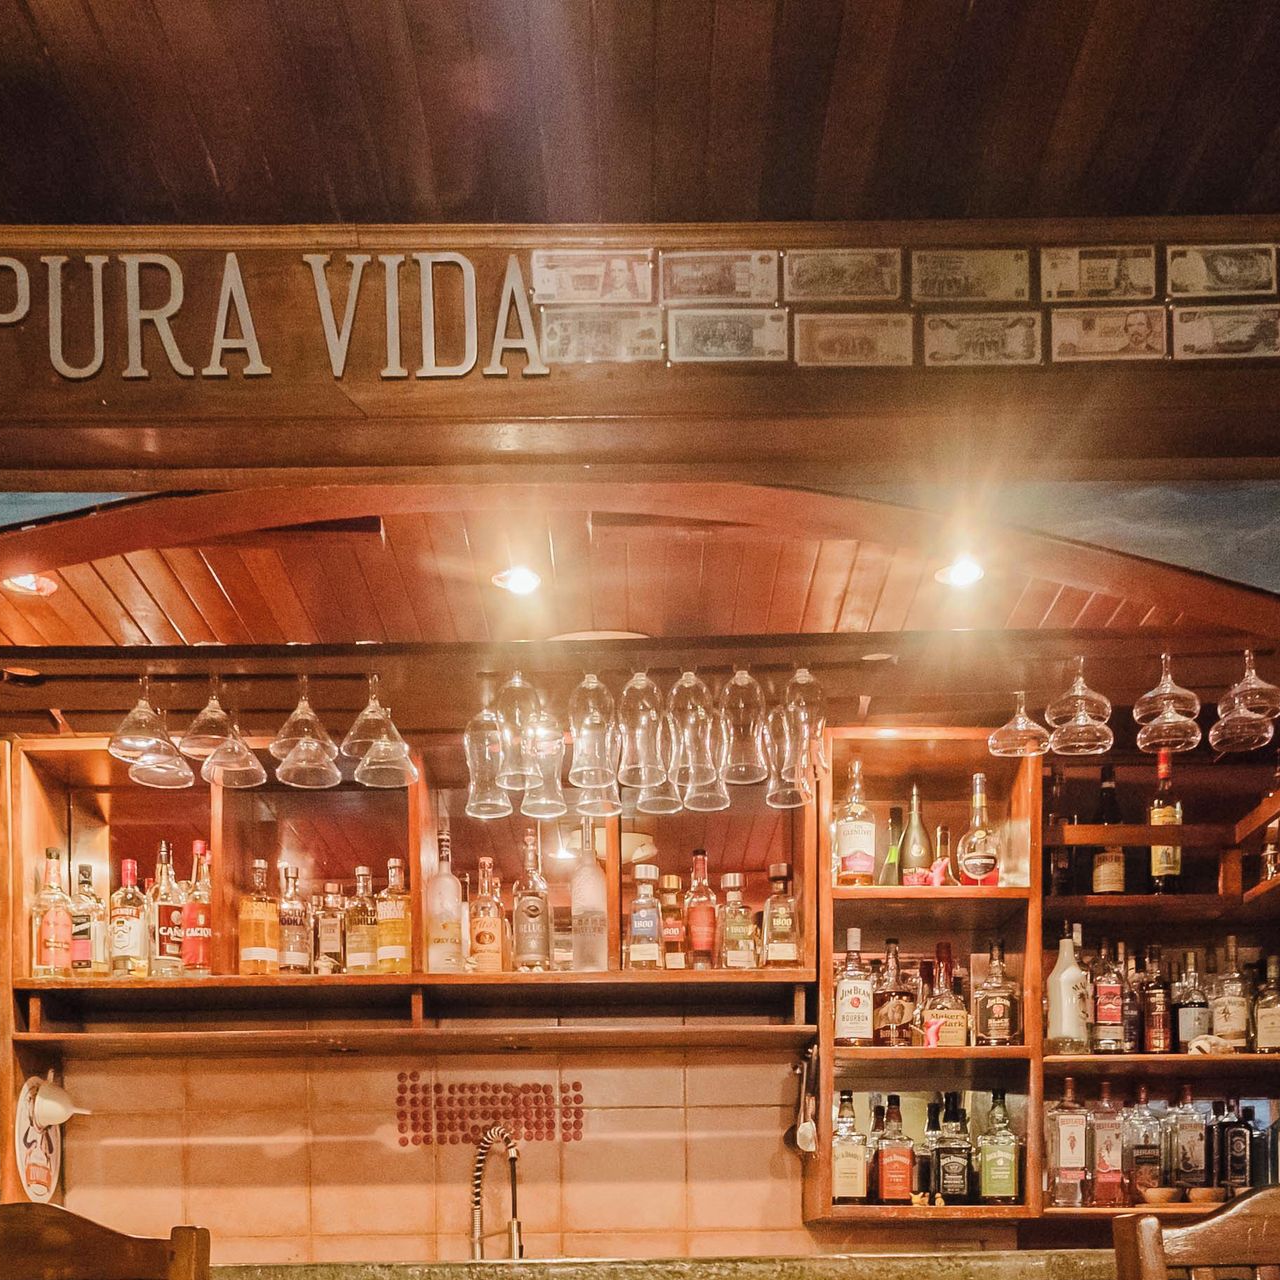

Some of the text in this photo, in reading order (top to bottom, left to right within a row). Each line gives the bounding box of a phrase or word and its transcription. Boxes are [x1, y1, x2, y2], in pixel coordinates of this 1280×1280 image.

[303, 253, 551, 381] VIDA
[634, 920, 654, 928] 1800
[772, 918, 792, 926] 1800
